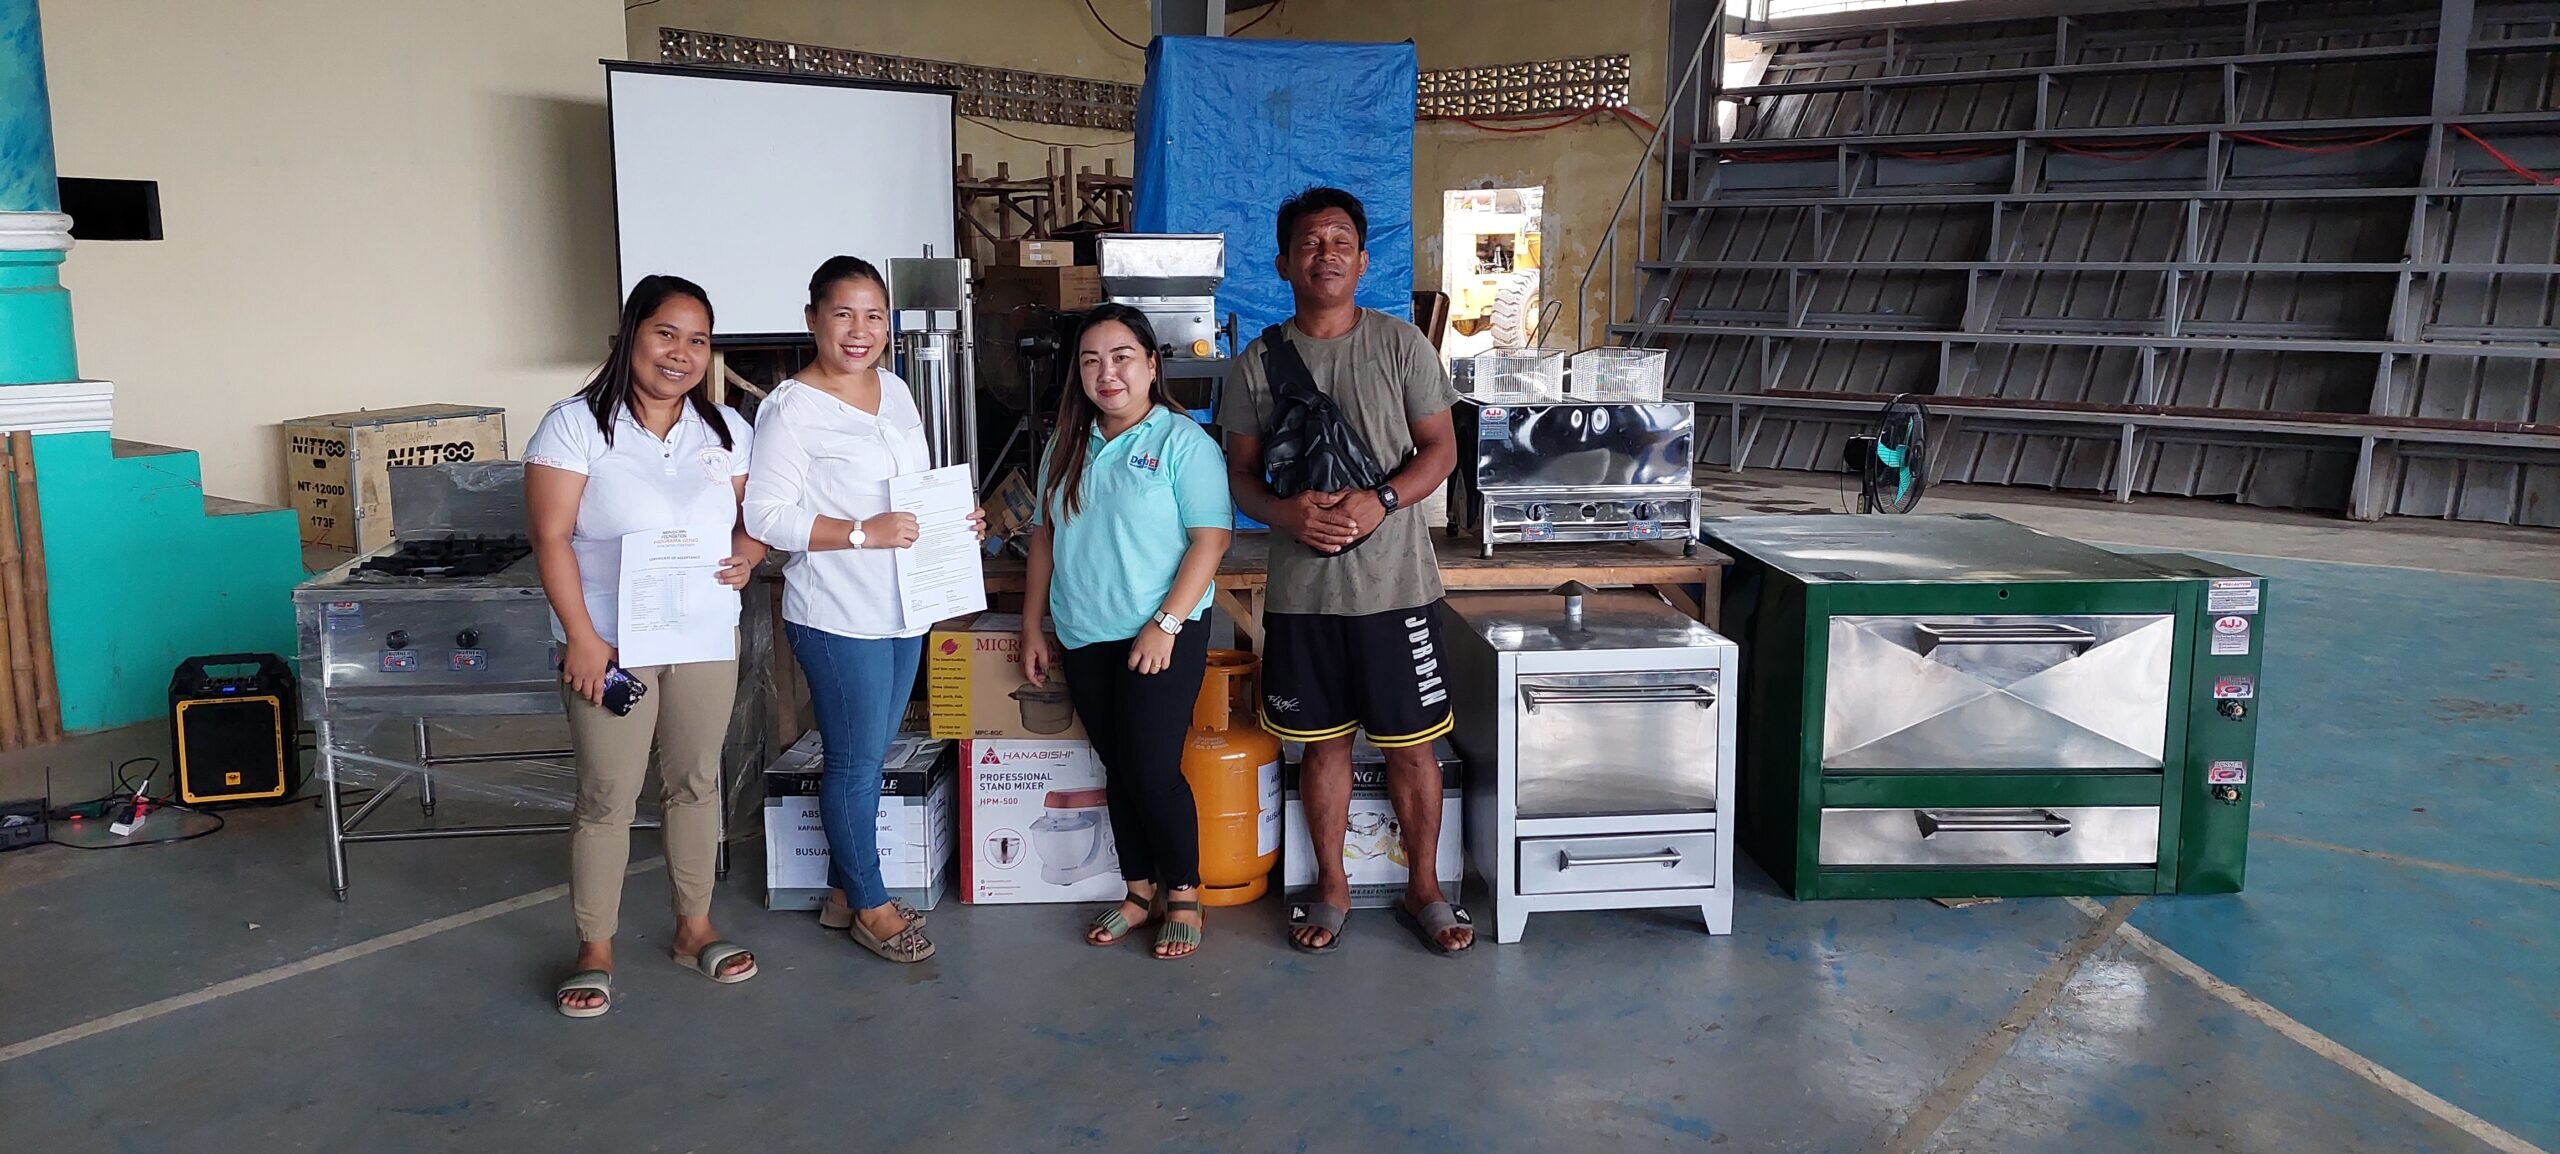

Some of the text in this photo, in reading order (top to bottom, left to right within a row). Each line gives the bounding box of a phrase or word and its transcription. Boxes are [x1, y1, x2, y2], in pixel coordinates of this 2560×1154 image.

[298, 481, 345, 495] NT-1200D
[312, 516, 335, 528] 173F
[2220, 619, 2243, 628] AJJ
[1003, 751, 1071, 760] HANABISHI
[980, 772, 1053, 781] PROFESSIONAL
[1014, 782, 1045, 790] MIXER
